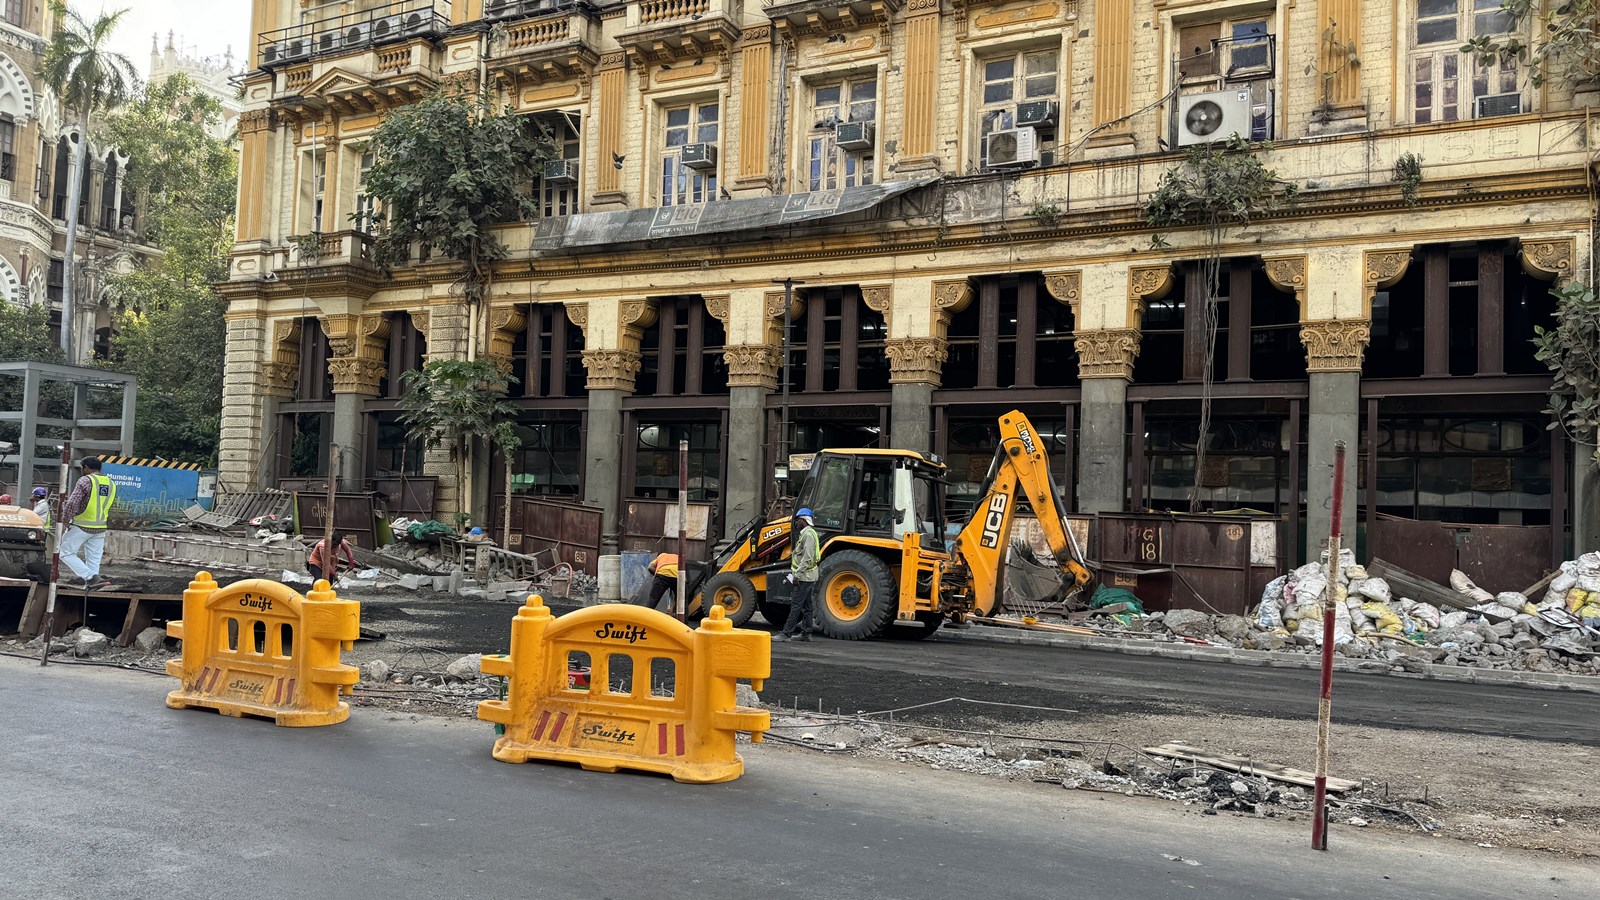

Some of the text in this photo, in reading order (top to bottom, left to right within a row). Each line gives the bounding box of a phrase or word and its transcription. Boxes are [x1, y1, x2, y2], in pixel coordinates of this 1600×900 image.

[809, 193, 836, 206] LIC
[675, 207, 700, 221] LIC
[106, 473, 134, 481] Mumbai
[112, 480, 142, 489] grading
[986, 493, 1007, 549] JCB
[763, 527, 782, 539] JCB
[1228, 528, 1242, 537] 181
[1141, 542, 1156, 560] 18
[239, 593, 273, 612] Swift
[595, 622, 648, 644] Swift
[229, 679, 264, 693] Swift
[582, 724, 636, 742] Swift
